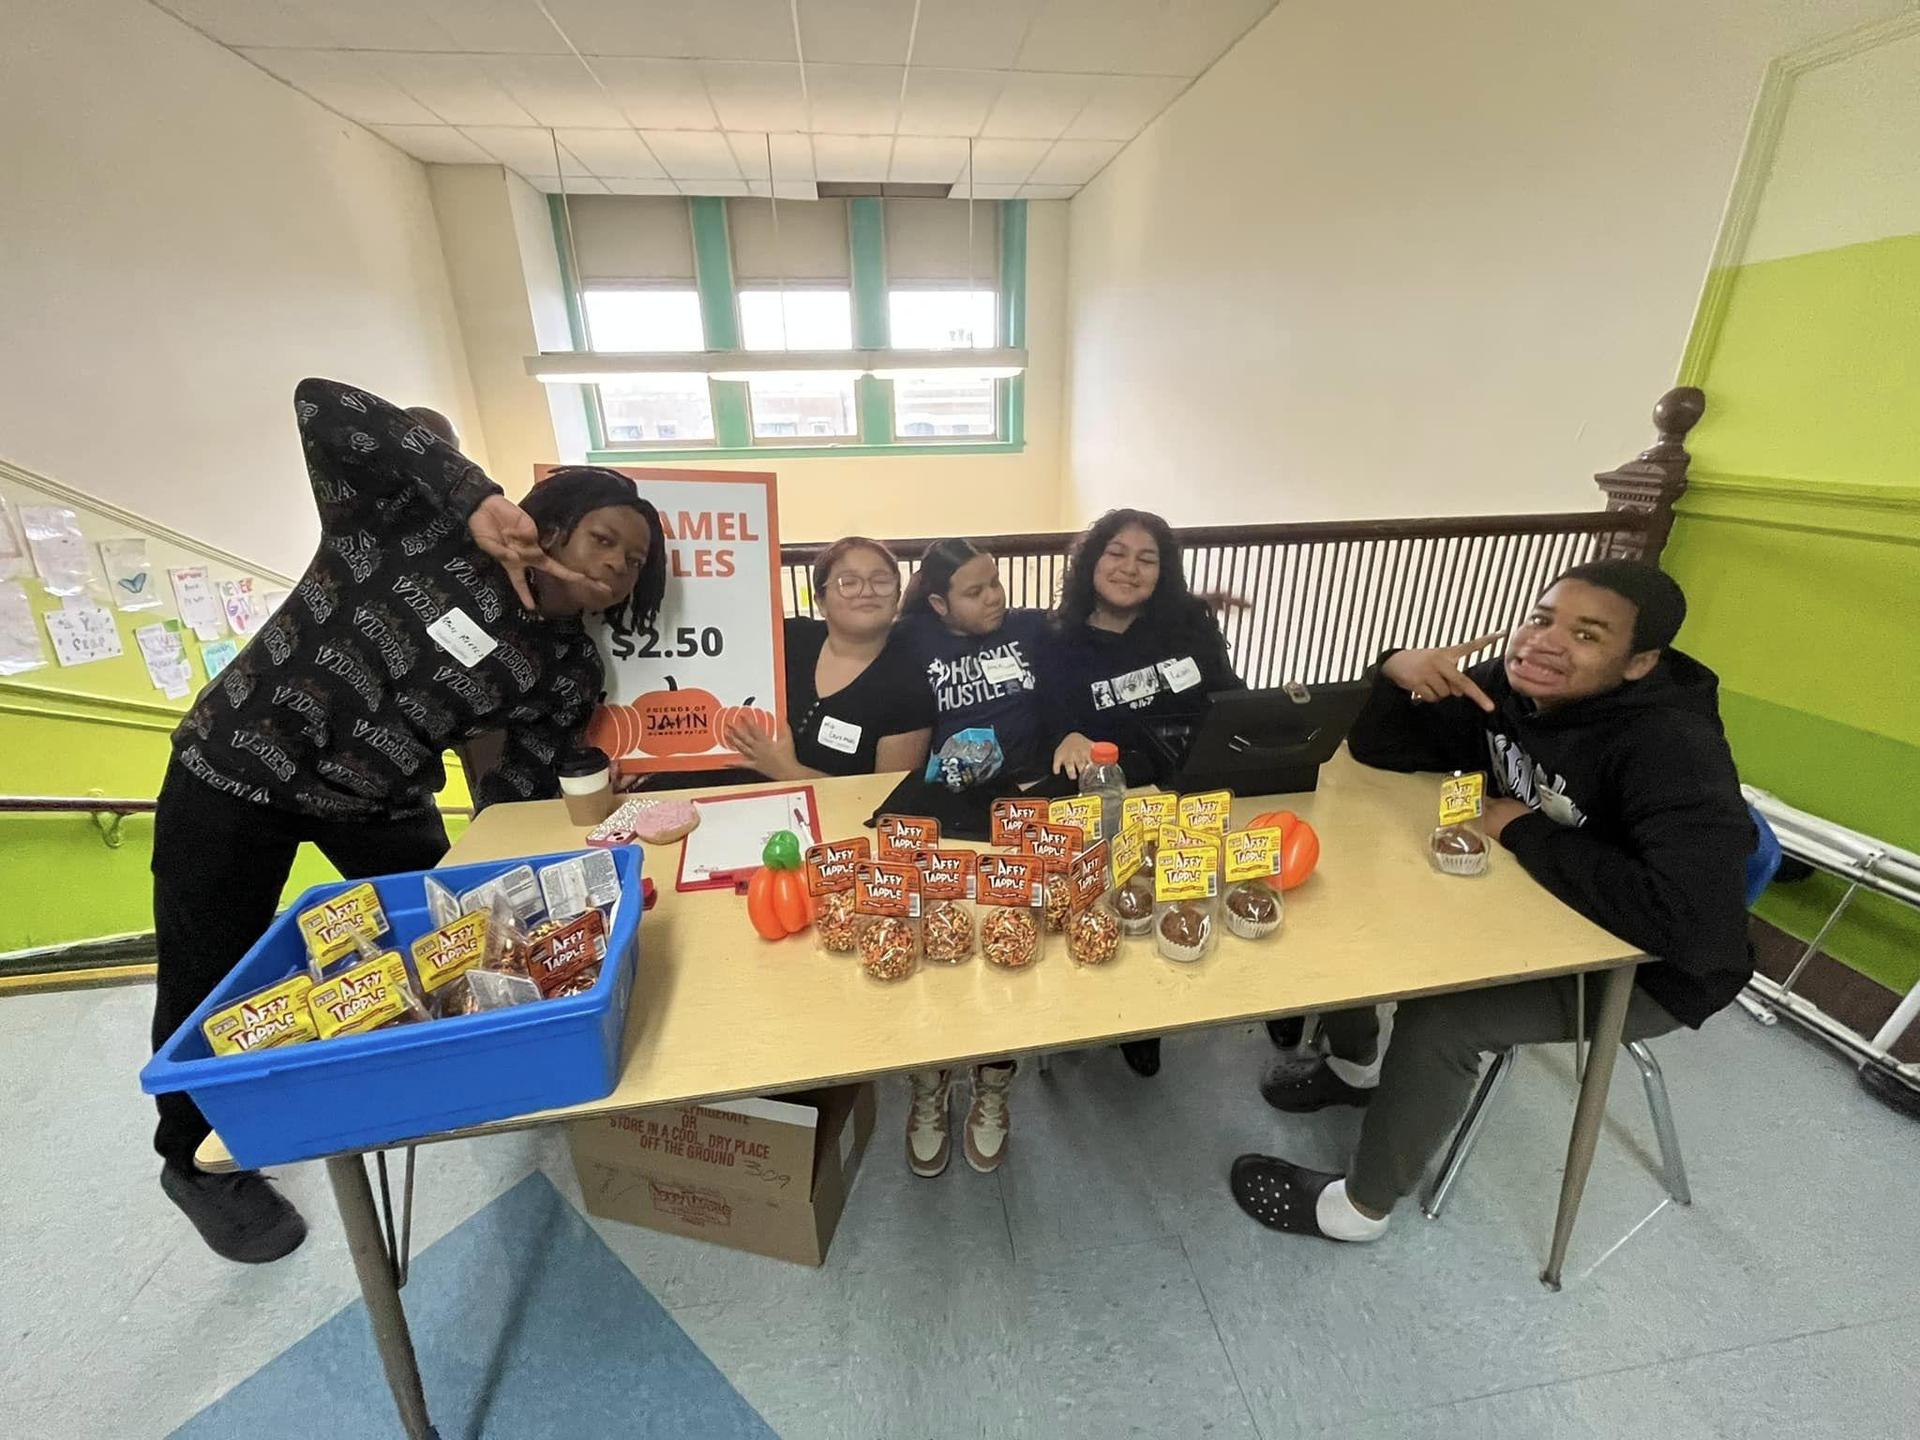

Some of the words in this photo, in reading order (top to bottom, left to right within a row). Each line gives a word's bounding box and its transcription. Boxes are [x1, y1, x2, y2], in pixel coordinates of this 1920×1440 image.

[659, 511, 759, 541] AMEL
[671, 549, 735, 577] LES
[392, 576, 440, 624] VIB
[611, 627, 723, 661] $2.50
[937, 679, 1006, 712] HUSTLE
[1009, 803, 1035, 819] AFFY
[897, 820, 922, 836] AFFY
[1001, 819, 1024, 832] TAPP
[888, 835, 922, 849] TAPPLE
[1040, 826, 1067, 844] AFFY
[1244, 833, 1269, 849] AFFY
[827, 847, 854, 863] AFFY
[1032, 842, 1066, 857] TAPPLE
[932, 854, 960, 871] AFFY
[998, 859, 1026, 876] AFFY
[1175, 851, 1203, 869] AFFY
[818, 863, 854, 878] TAPPLE
[875, 867, 902, 885] AFFY
[923, 870, 960, 884] TAPPLE
[1165, 868, 1201, 884] TAPPLE
[865, 882, 902, 900] TAPPLE
[988, 875, 1026, 890] TAPPLE
[438, 923, 474, 950] AFFY
[552, 929, 585, 955] AFFY
[427, 937, 477, 969] TAPPLE
[543, 943, 587, 972] TAPPLE
[340, 970, 382, 1002] AFFY
[240, 995, 289, 1029] AFFY
[327, 987, 386, 1022] TAPPLE
[228, 1012, 295, 1051] TAPPLE
[682, 1115, 697, 1129] OR
[610, 1116, 644, 1134] STORE
[647, 1122, 658, 1136] IN
[661, 1126, 669, 1139] A
[709, 1134, 732, 1150] DRY
[735, 1139, 770, 1159] PLACE
[640, 1135, 661, 1151] OFF
[664, 1139, 685, 1157] THE
[687, 1144, 735, 1167] GROUND
